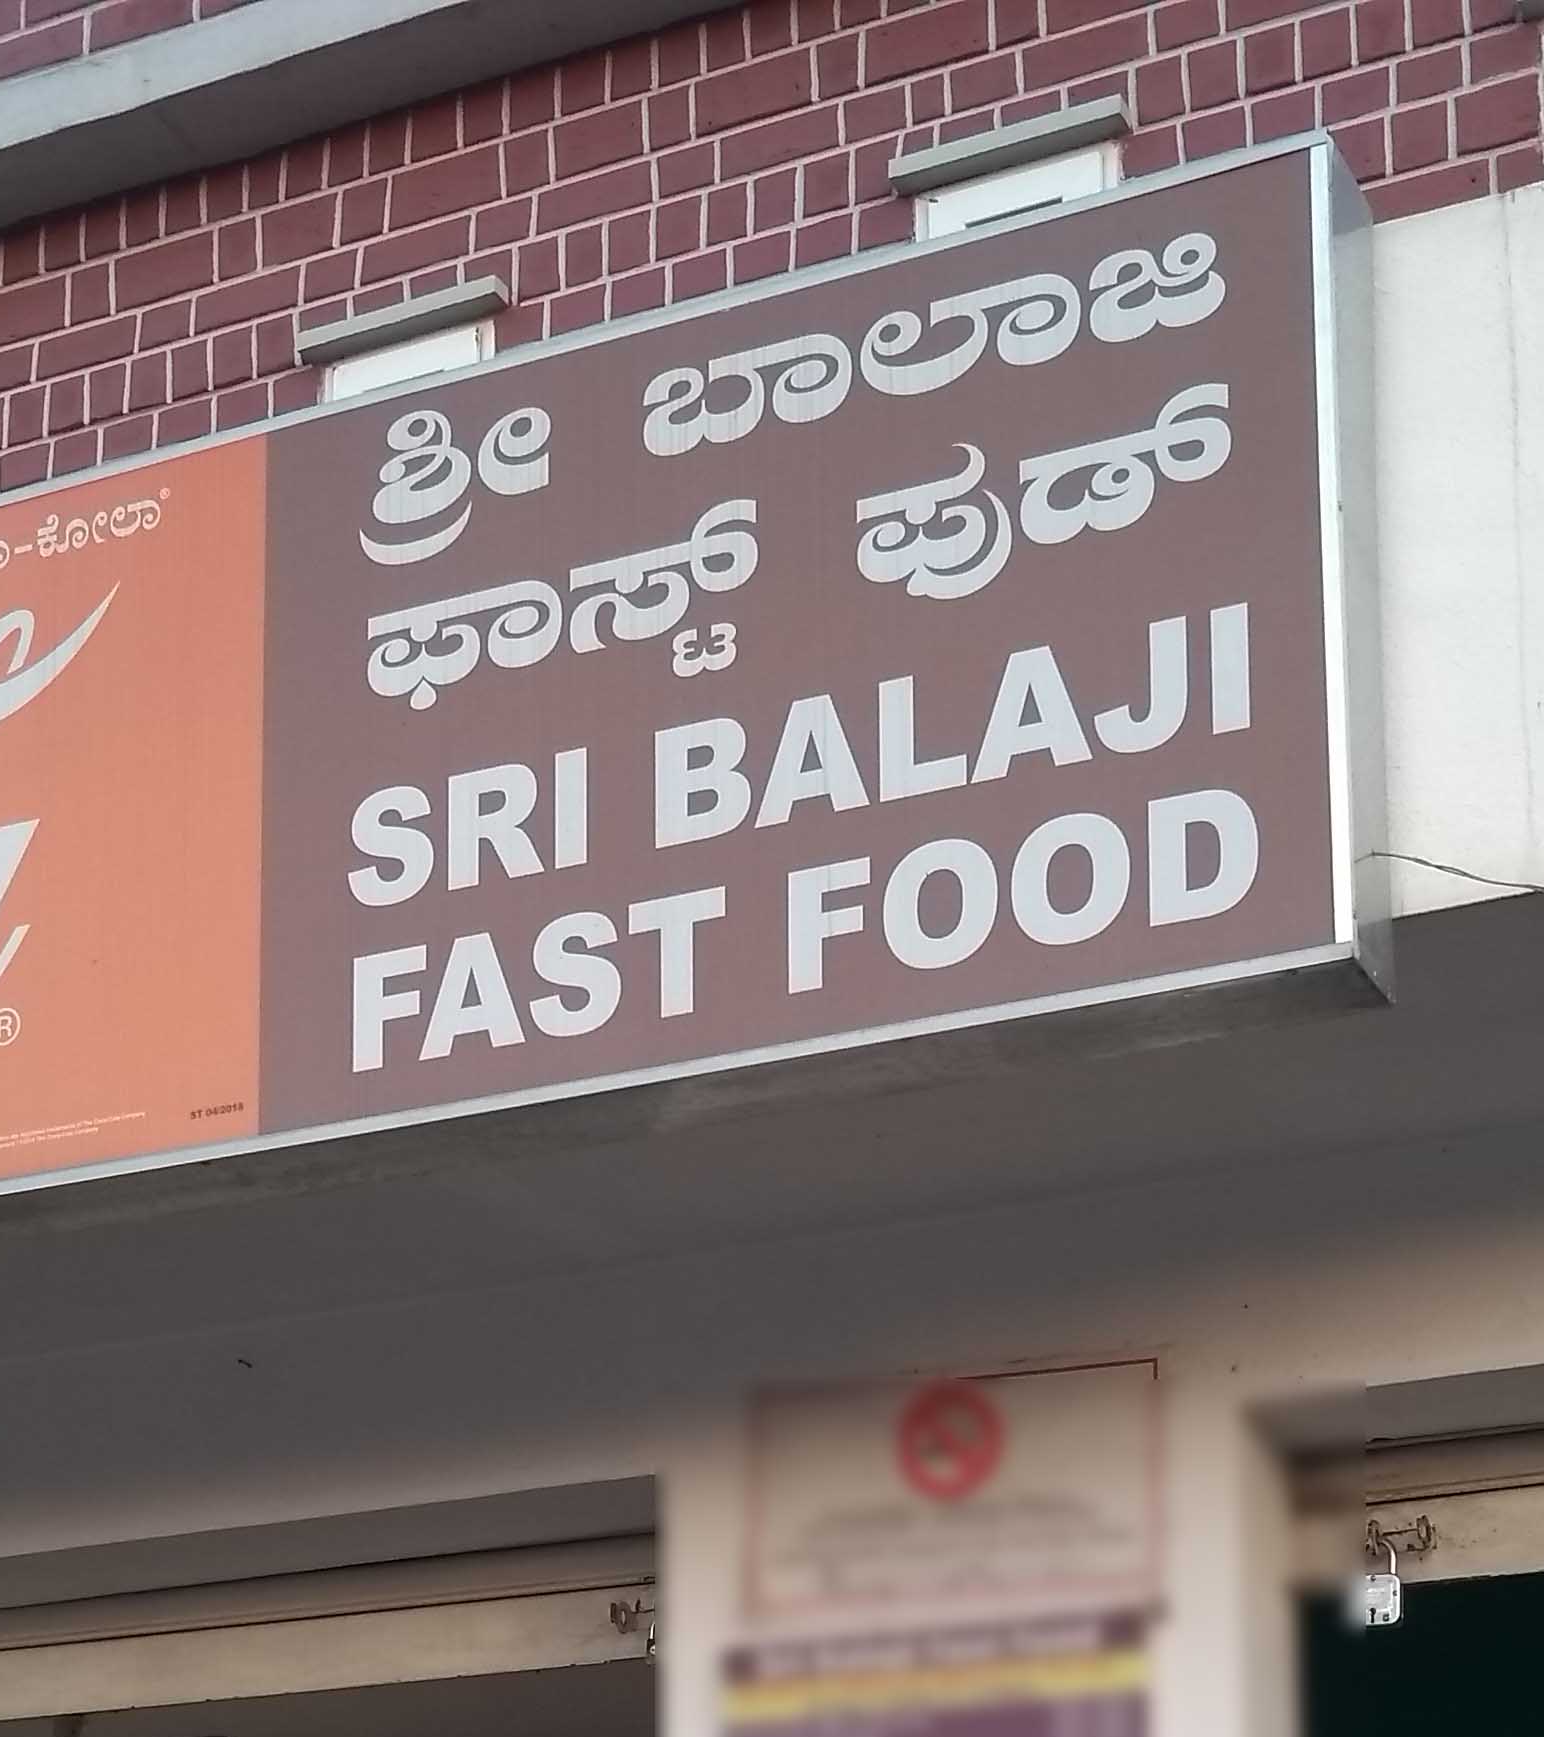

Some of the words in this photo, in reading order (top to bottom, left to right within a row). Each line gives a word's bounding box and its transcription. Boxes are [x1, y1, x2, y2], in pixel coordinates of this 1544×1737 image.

[360, 407, 552, 566] ಶ್ರೀ
[643, 233, 1225, 456] ಬಾಲಾಜಿ
[367, 499, 759, 710] ಫಾಸ್ಟ್
[348, 747, 588, 906] SRI
[655, 602, 1251, 849] BALAJI
[353, 886, 726, 1073] FAST
[788, 789, 1259, 994] FOOD
